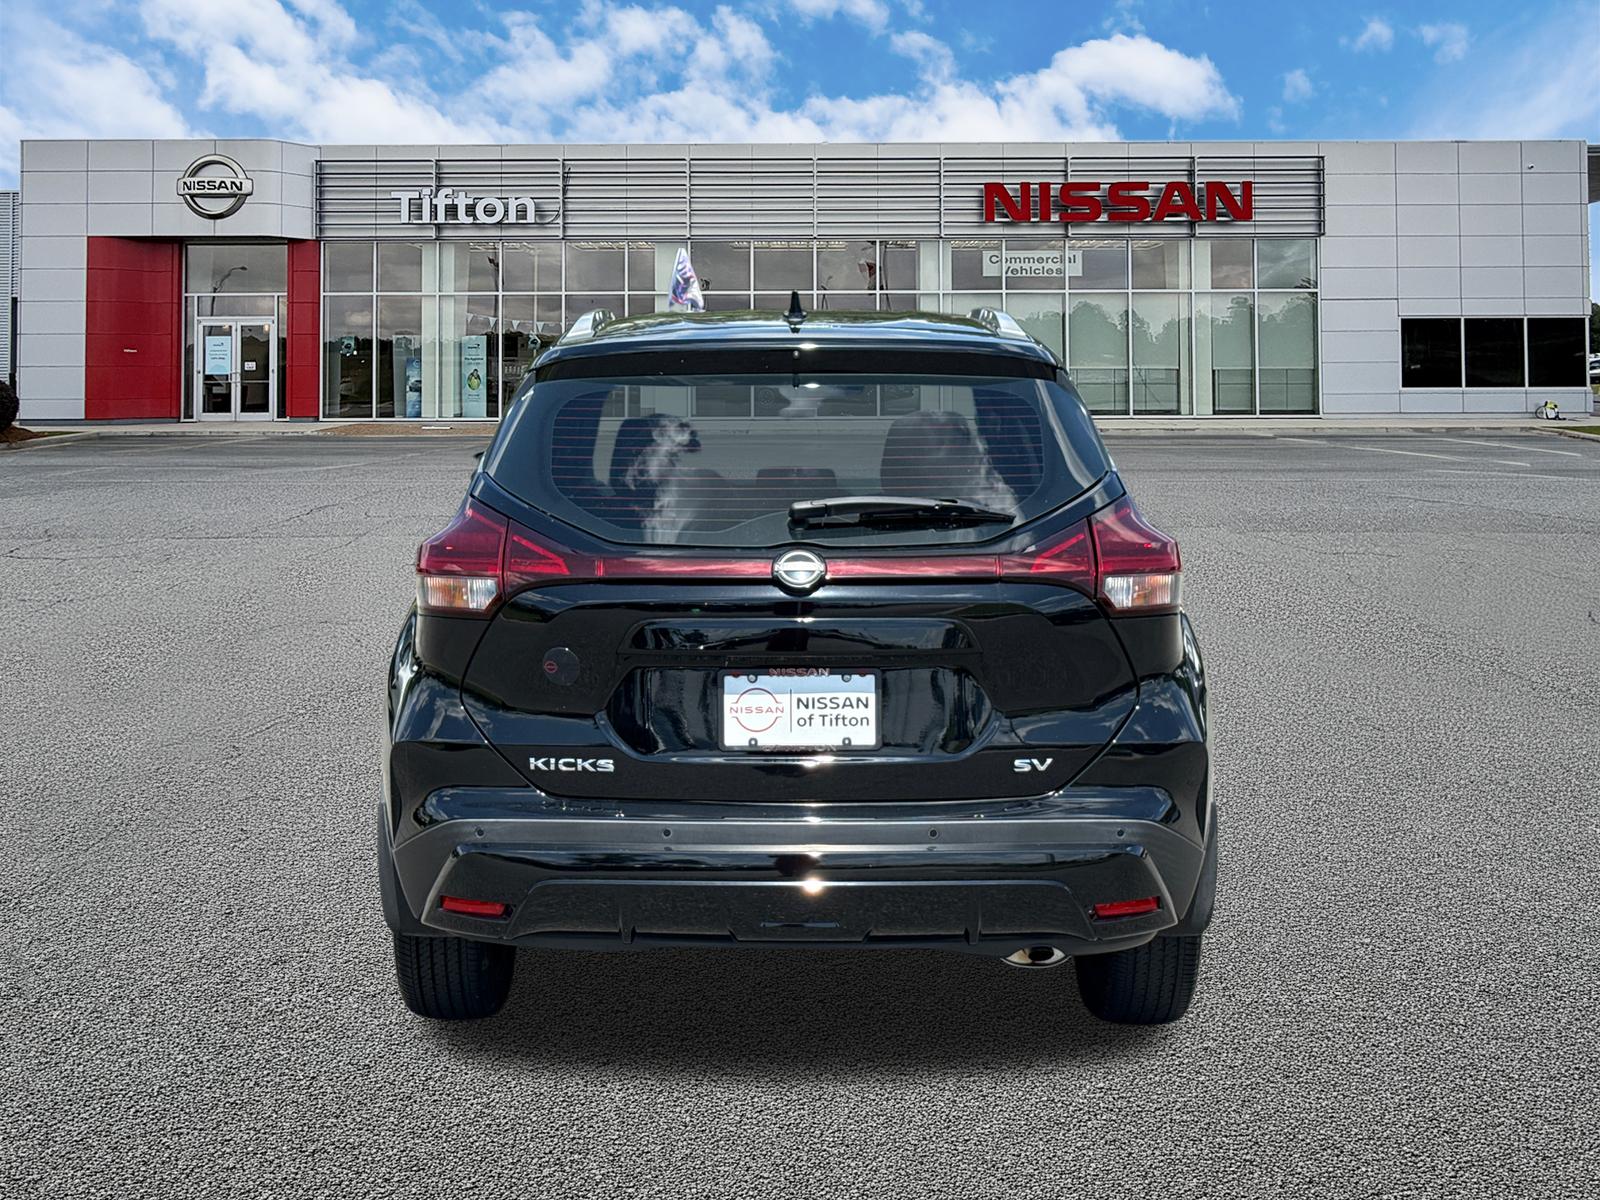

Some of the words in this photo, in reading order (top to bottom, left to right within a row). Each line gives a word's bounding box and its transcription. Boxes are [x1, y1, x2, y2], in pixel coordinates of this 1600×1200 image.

[182, 180, 243, 191] NISSAN
[391, 187, 536, 224] Tifton
[983, 181, 1253, 222] NISSAN
[768, 667, 830, 677] NISSAN
[729, 706, 785, 714] NISSAN
[796, 696, 870, 710] NISSAN
[796, 713, 815, 727] of
[818, 713, 870, 727] Tifton
[529, 757, 615, 772] KICKS
[1013, 758, 1053, 772] SV
